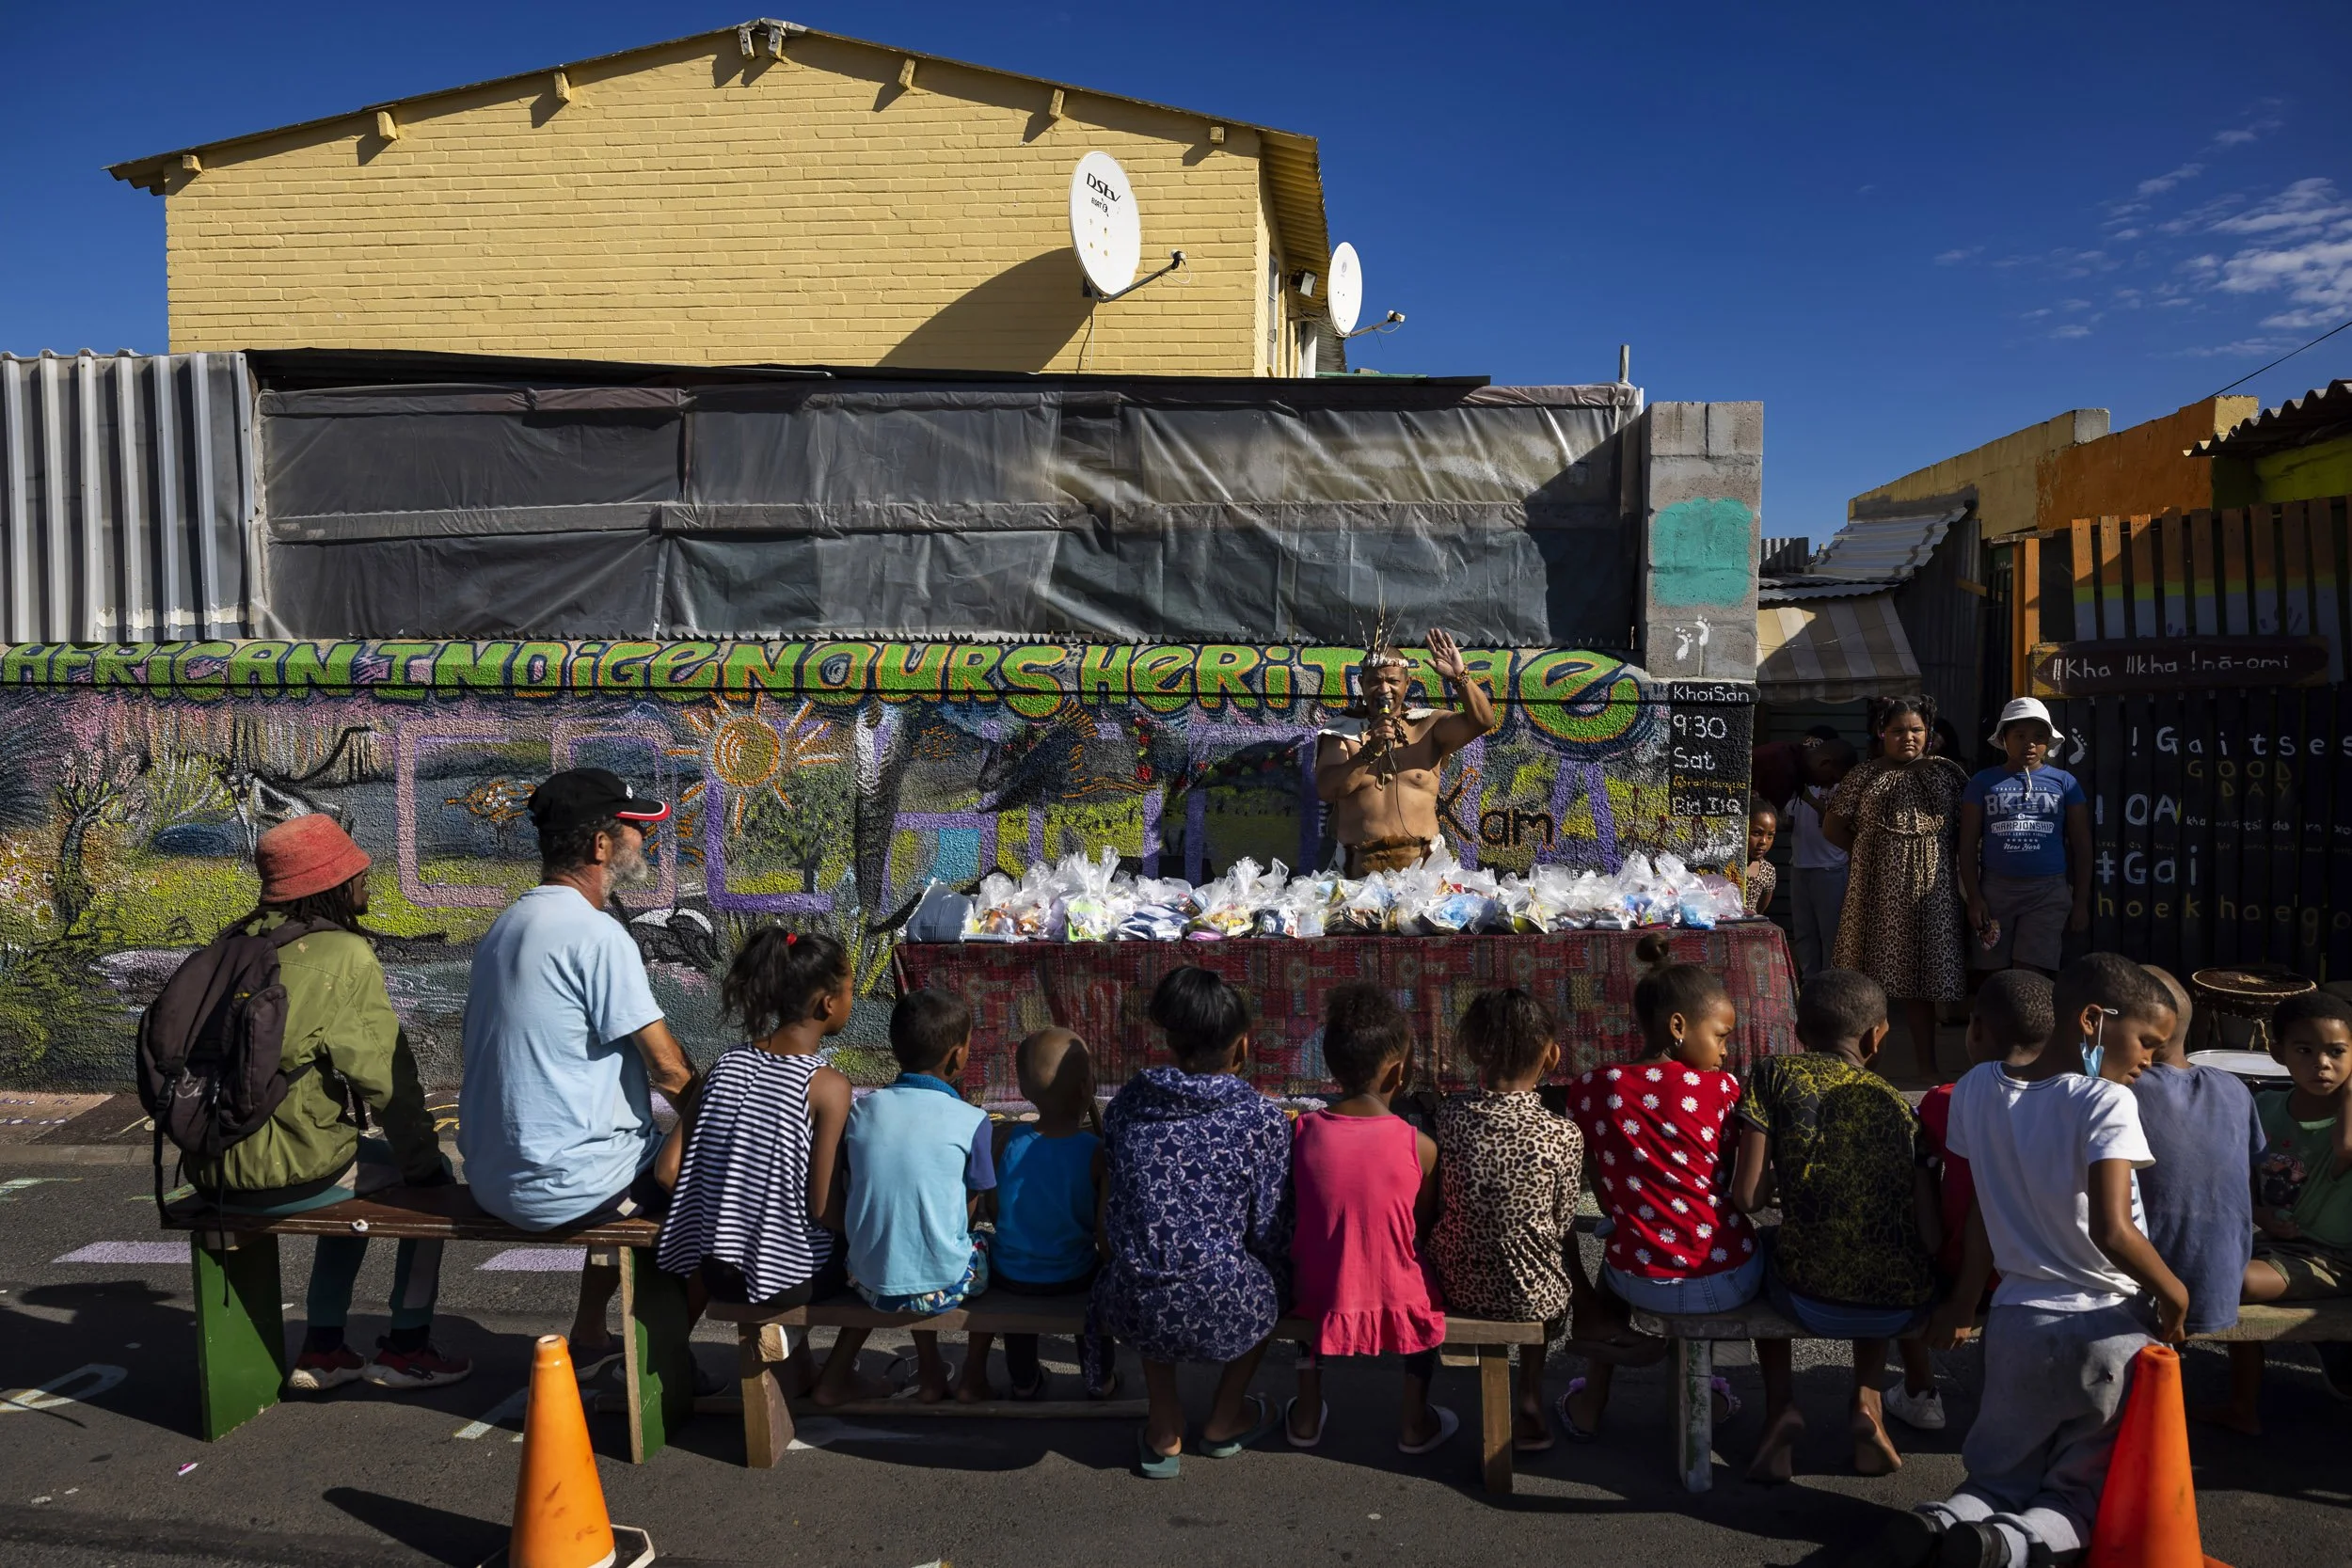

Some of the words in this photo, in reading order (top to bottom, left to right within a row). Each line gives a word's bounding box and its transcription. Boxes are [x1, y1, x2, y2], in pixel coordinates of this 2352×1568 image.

[1673, 713, 1728, 740] 9:30
[1674, 746, 1716, 770] Sat
[1992, 821, 2054, 832] CHAMPIONSHIP
